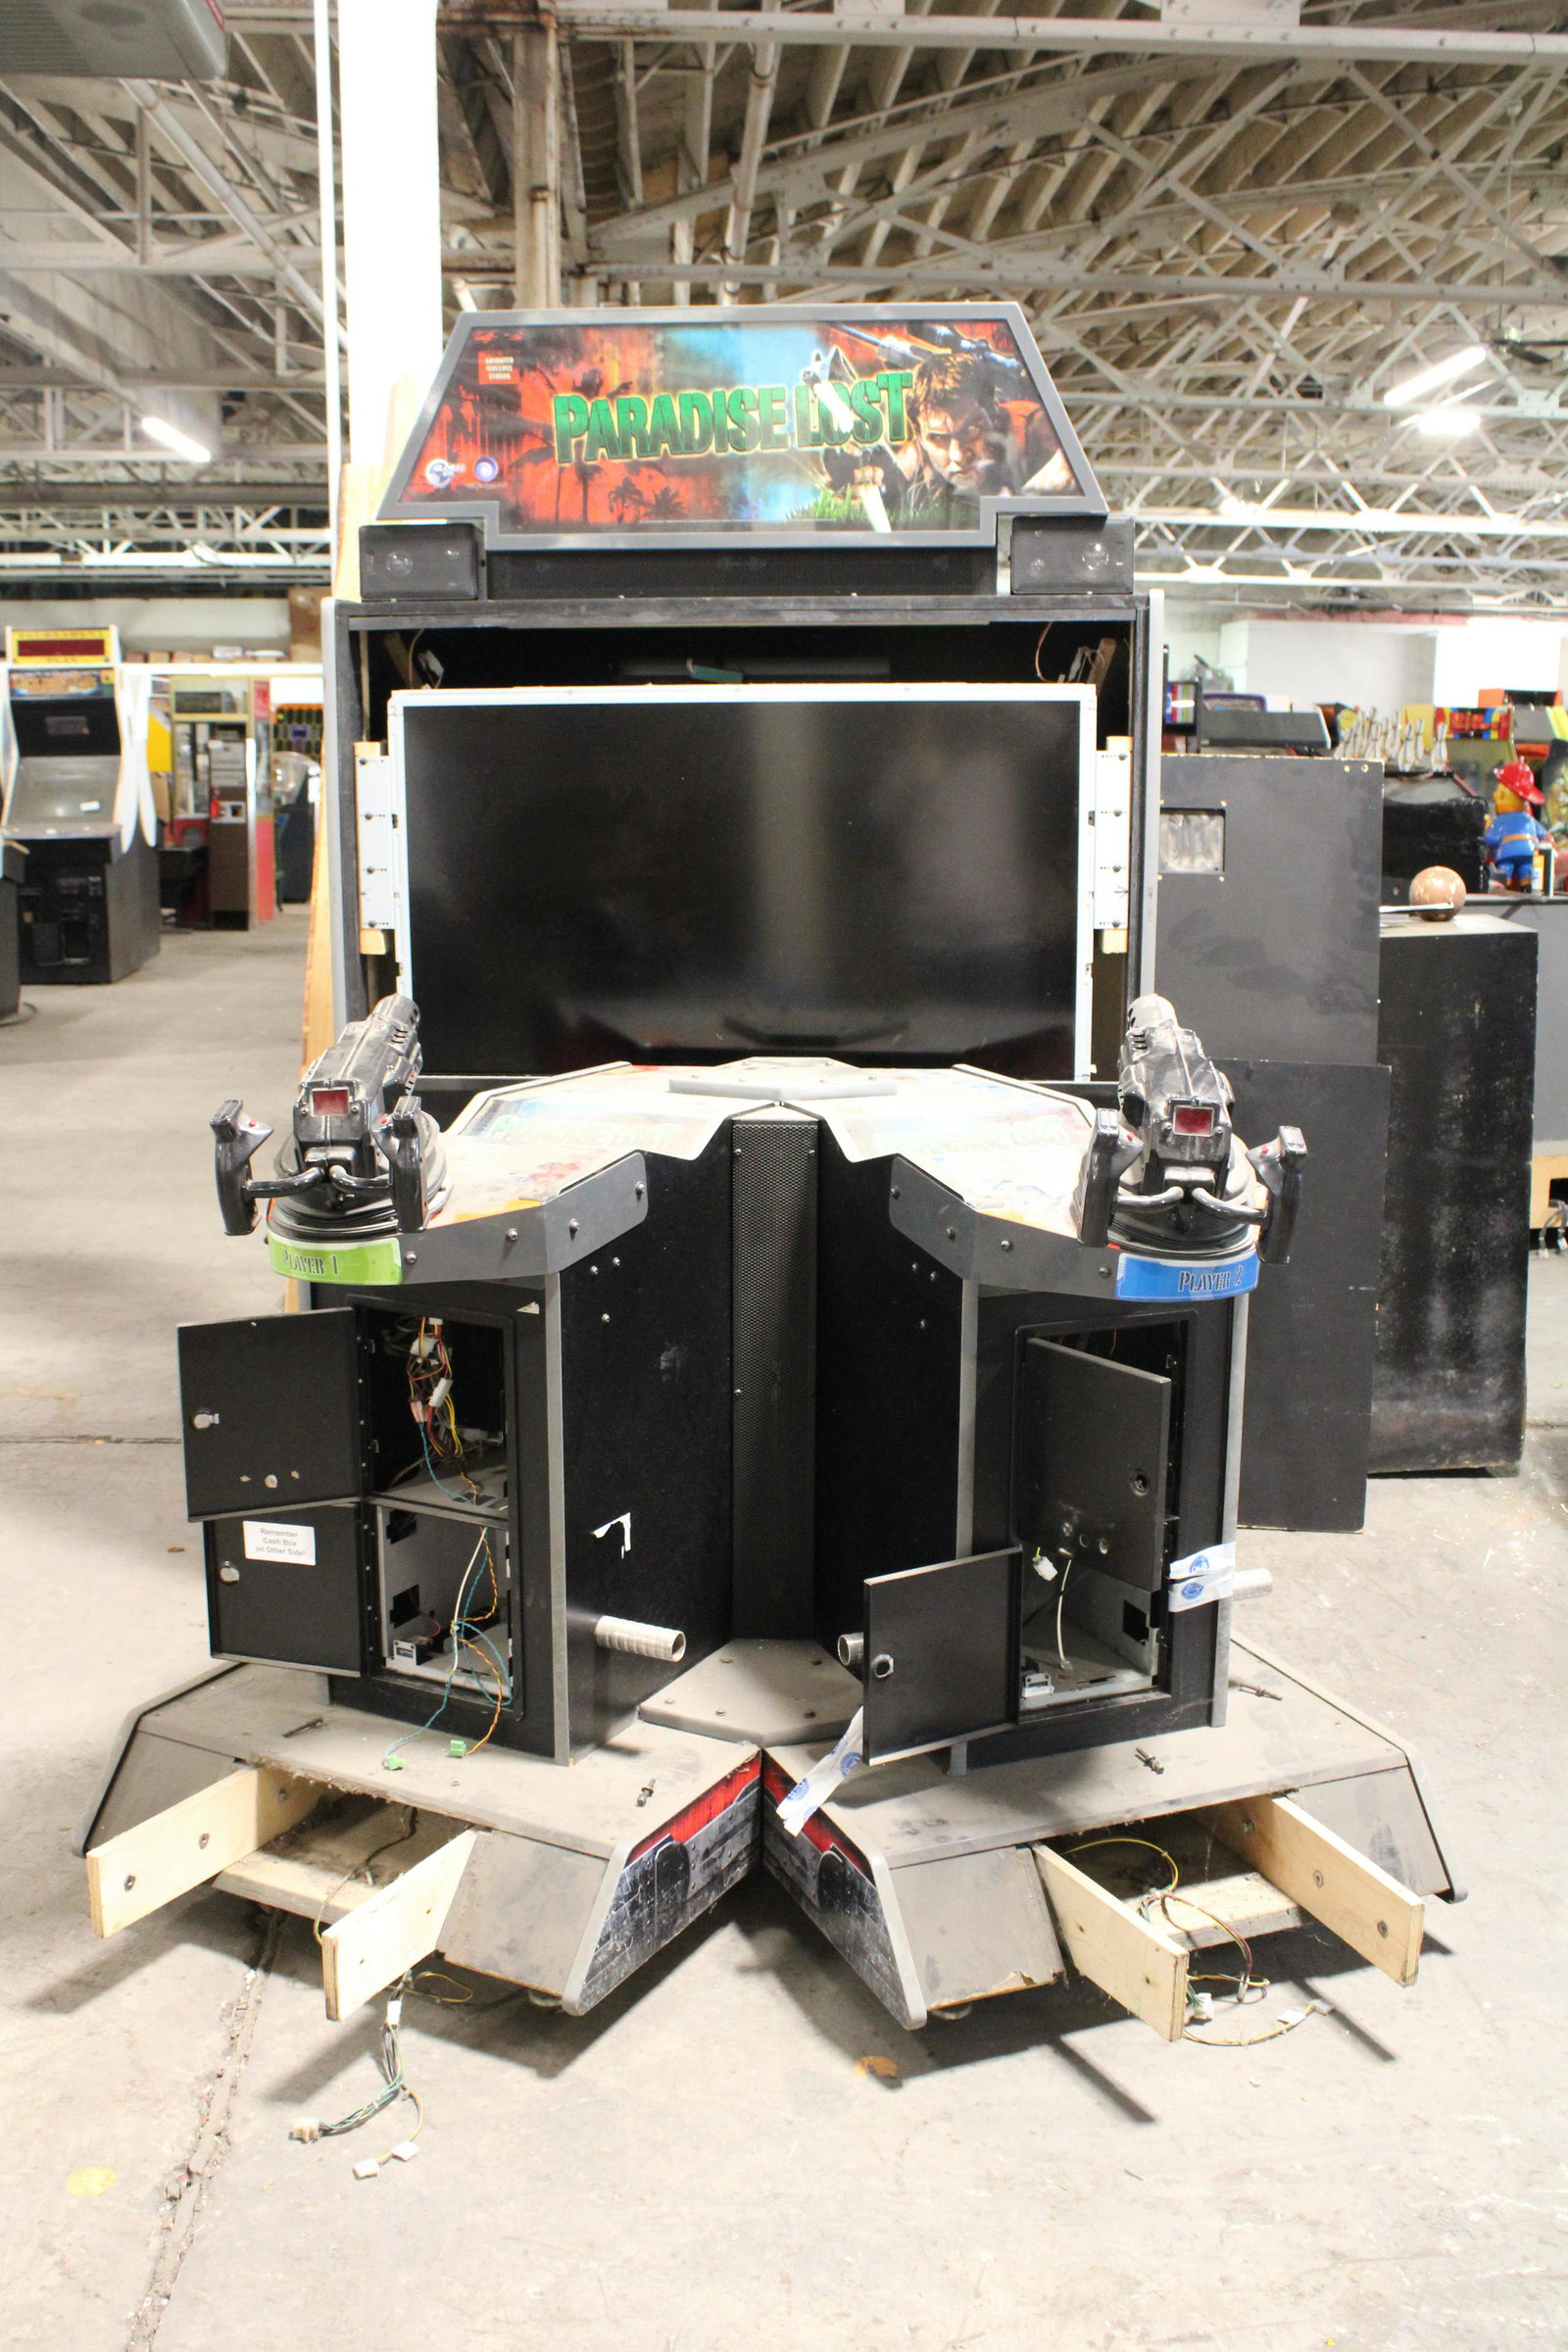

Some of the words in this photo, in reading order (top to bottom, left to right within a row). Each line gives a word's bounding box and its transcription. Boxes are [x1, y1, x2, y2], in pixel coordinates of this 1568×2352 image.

[554, 387, 789, 463] PARADISE
[796, 372, 912, 447] LOST
[281, 1249, 324, 1275] PLAYER
[329, 1254, 339, 1275] 1
[1177, 1270, 1231, 1292] PLAYER
[1234, 1264, 1244, 1287] 2
[260, 1528, 298, 1537] Remember
[266, 1545, 286, 1554] Other
